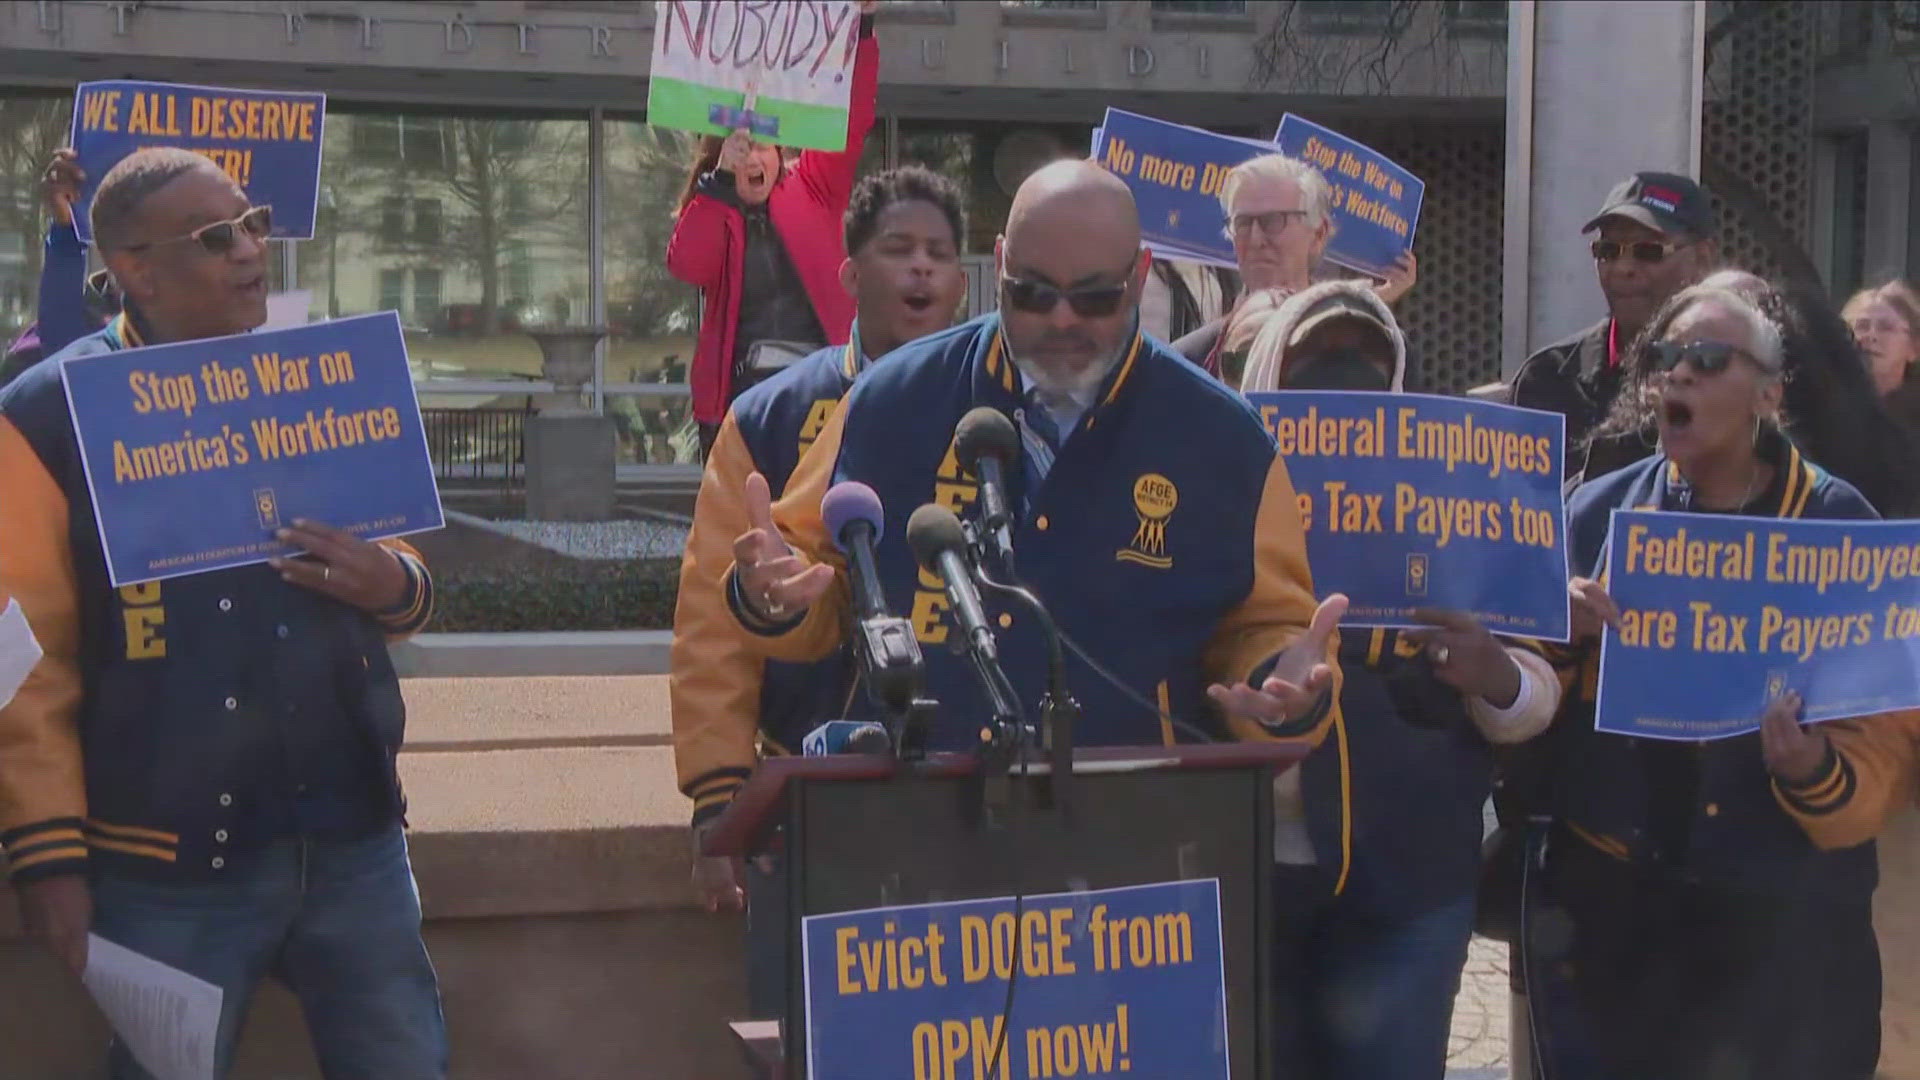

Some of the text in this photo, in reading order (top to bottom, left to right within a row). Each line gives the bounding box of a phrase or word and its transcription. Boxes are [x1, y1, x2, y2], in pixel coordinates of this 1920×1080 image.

[83, 91, 316, 143] WE ALL DESERVE
[1106, 137, 1232, 197] No more DO
[1304, 136, 1403, 199] Stop the War on
[1346, 190, 1409, 237] Workforce
[129, 351, 355, 417] Stop the War on
[113, 406, 401, 484] America's Workforce
[1397, 407, 1551, 478] Employees
[1141, 479, 1172, 499] AFGE
[1324, 481, 1383, 533] Tax
[1395, 482, 1501, 548] Payers
[1510, 497, 1554, 548] too
[1626, 524, 1754, 581] Federal
[1620, 609, 1678, 648] are
[1690, 601, 1748, 653] Tax
[1758, 605, 1873, 663] Payers
[835, 904, 1193, 995] Evict DOGE from
[912, 1004, 1131, 1080] OPM now!
